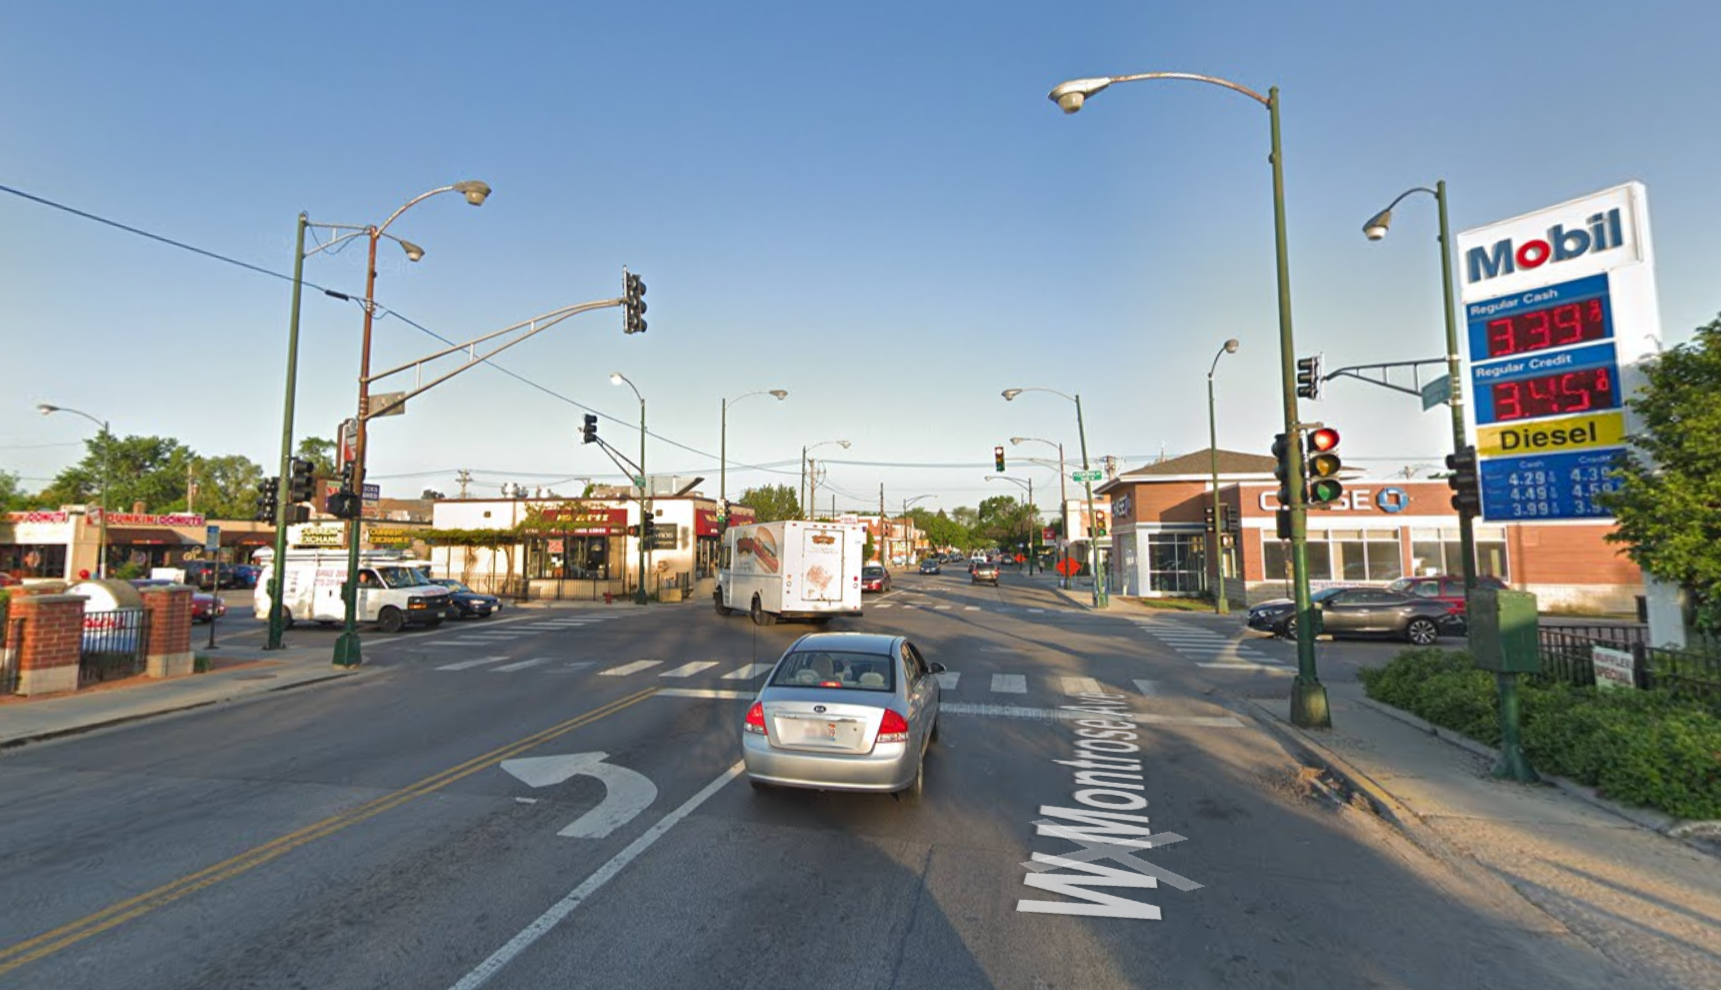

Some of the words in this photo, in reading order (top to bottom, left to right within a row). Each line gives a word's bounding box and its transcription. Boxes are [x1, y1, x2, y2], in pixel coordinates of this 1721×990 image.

[1466, 207, 1623, 284] Mobil
[1470, 299, 1518, 316] Regular
[1523, 288, 1558, 304] Cash
[1475, 362, 1525, 378] Regular
[1529, 354, 1572, 370] Credit
[1500, 421, 1597, 449] Diesel
[1519, 460, 1545, 468] Cash
[1509, 472, 1545, 485] 4.29
[1510, 486, 1547, 500] 4.49
[1512, 502, 1548, 516] 3.99
